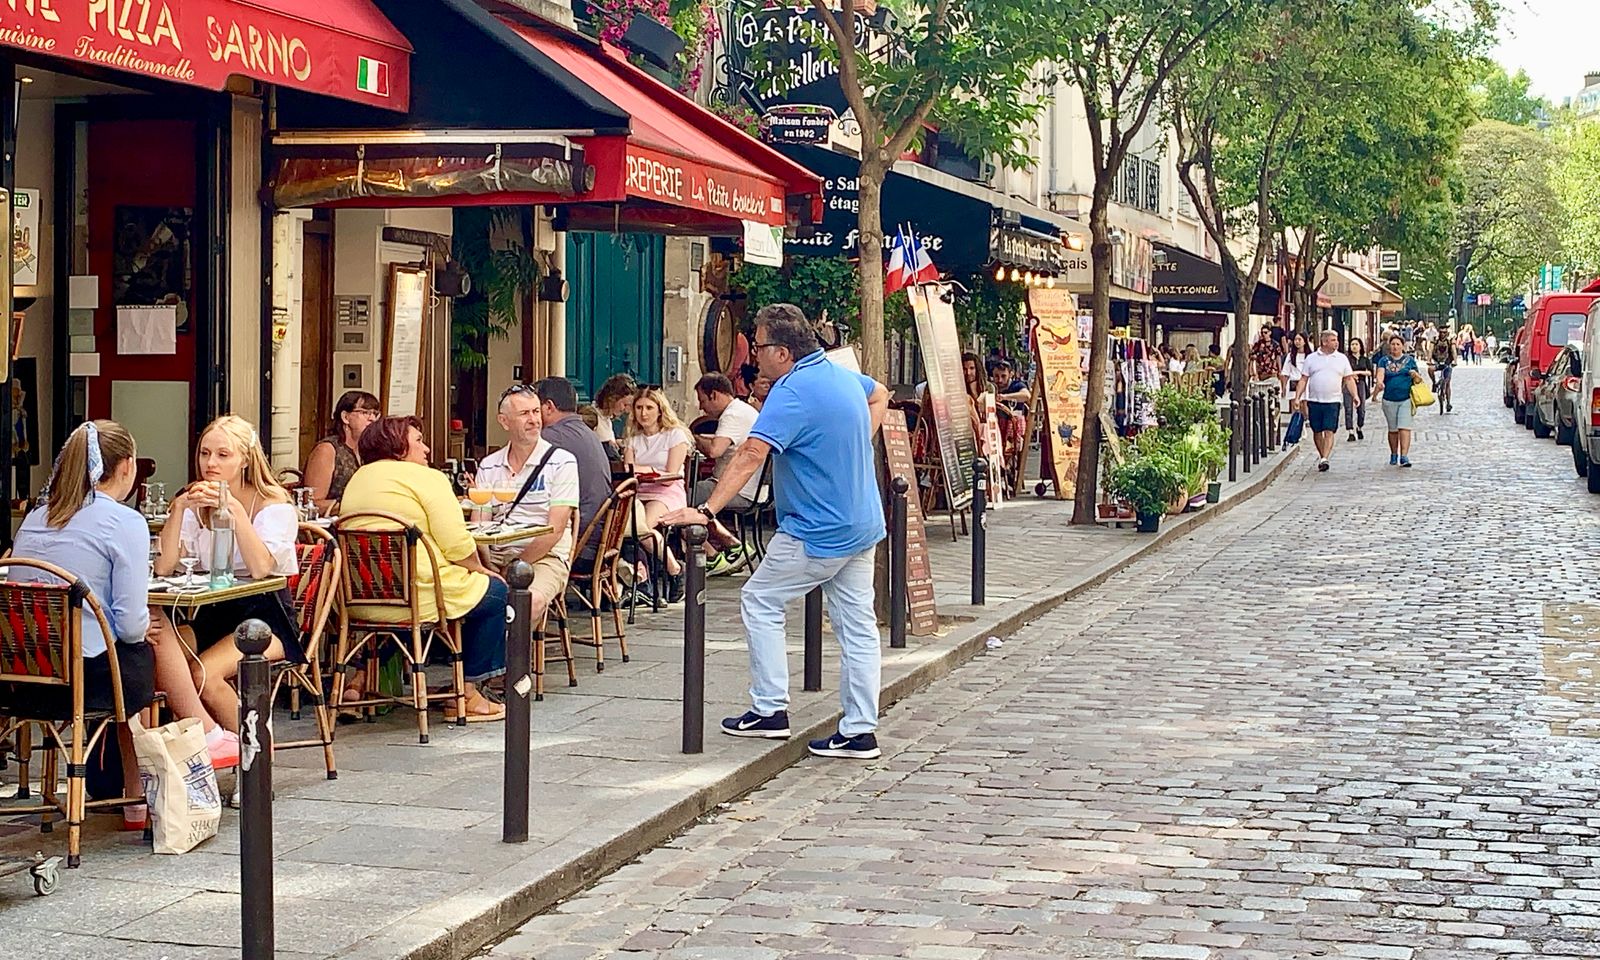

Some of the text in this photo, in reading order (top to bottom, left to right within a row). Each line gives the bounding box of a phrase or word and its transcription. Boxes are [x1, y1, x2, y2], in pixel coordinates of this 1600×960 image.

[89, 0, 312, 82] PIZZA SARNO
[0, 20, 195, 80] uisine Traditionnelle
[769, 115, 801, 126] Maison
[795, 128, 816, 139] 1902
[836, 176, 860, 191] Sal
[691, 176, 705, 202] La
[707, 177, 731, 209] Petite
[829, 195, 859, 214] étag
[1151, 285, 1219, 295] RADITIONNEL
